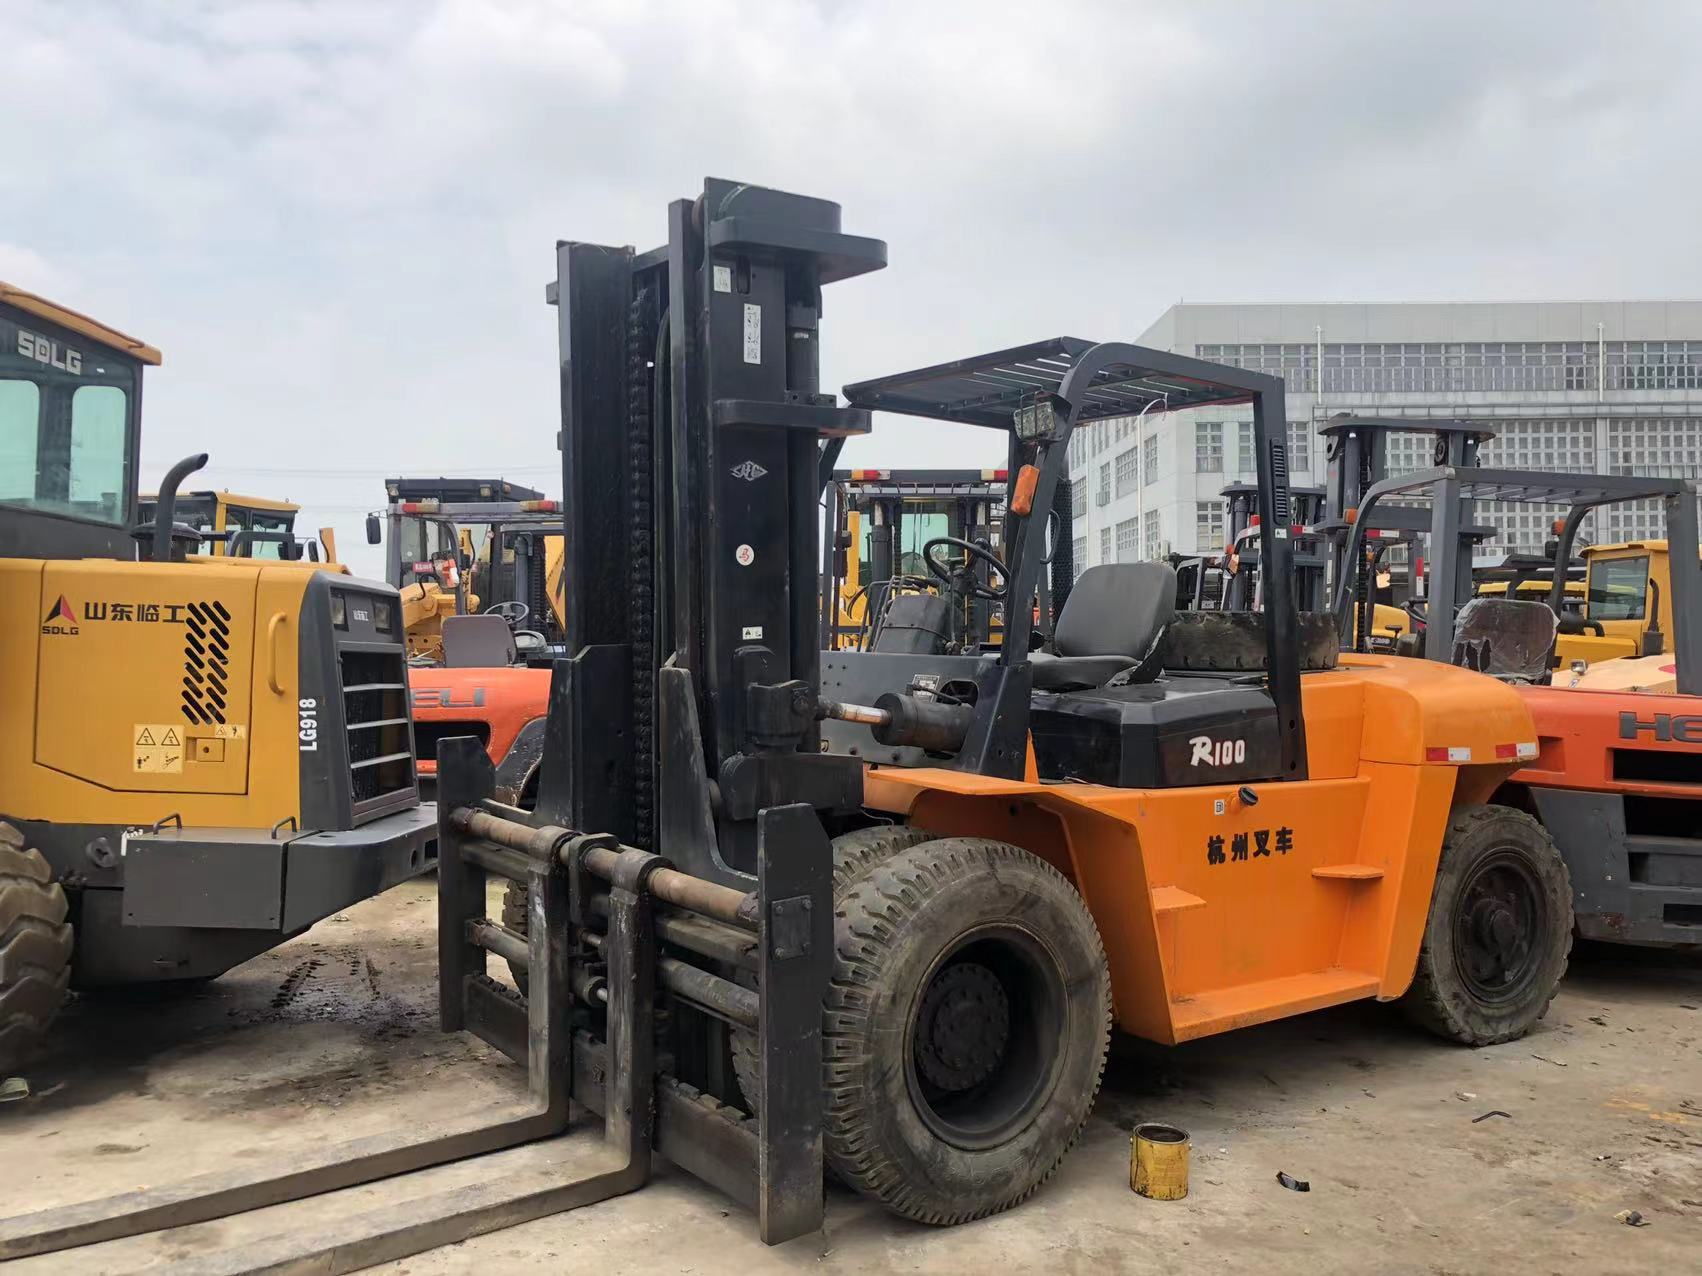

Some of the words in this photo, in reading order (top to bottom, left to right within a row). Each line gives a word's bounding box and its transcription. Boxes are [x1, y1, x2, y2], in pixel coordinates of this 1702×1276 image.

[17, 329, 82, 376] SDLG
[42, 625, 79, 636] SDLG
[84, 601, 186, 624] 山东临工
[299, 698, 318, 751] LG918
[1189, 735, 1246, 767] R100
[1207, 826, 1294, 866] 杭州叉车
